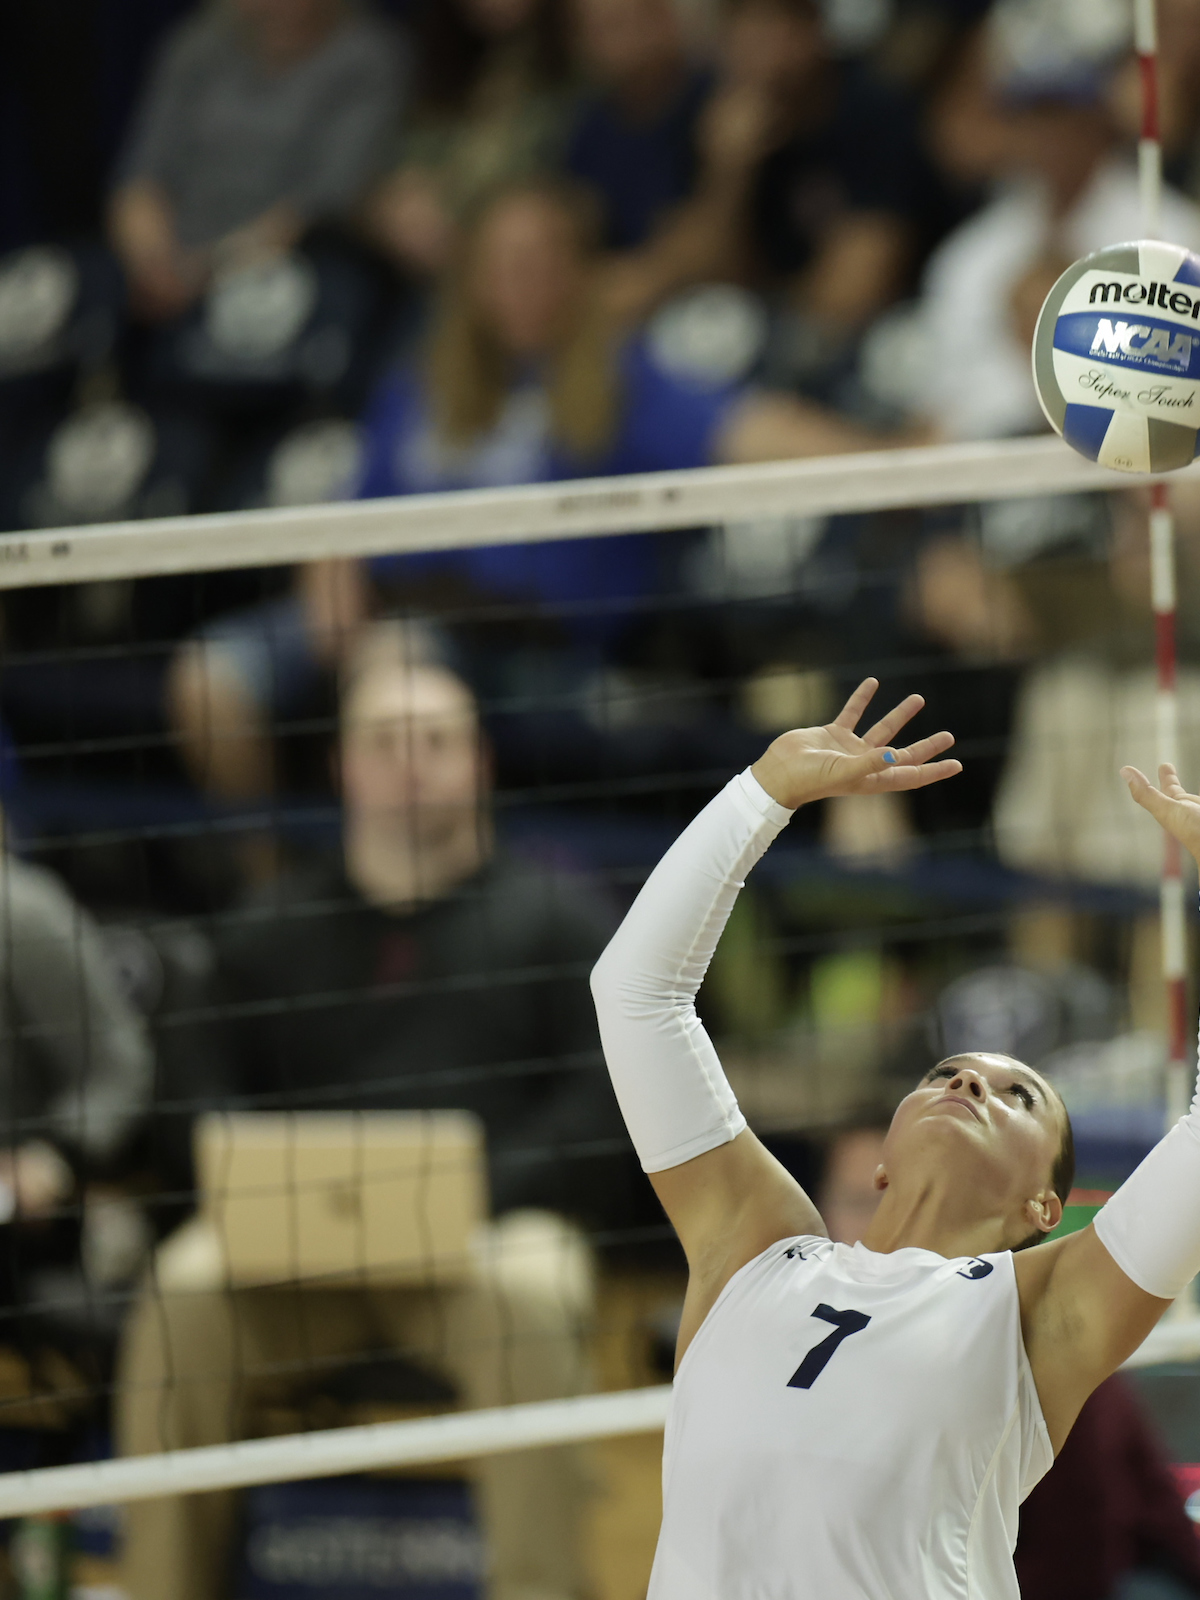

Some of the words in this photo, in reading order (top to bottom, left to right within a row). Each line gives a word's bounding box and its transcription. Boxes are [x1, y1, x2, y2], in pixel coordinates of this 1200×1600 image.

[1091, 318, 1192, 369] NCAA
[1079, 369, 1130, 400] Super
[1137, 385, 1195, 409] Touch
[786, 1303, 872, 1389] 7
